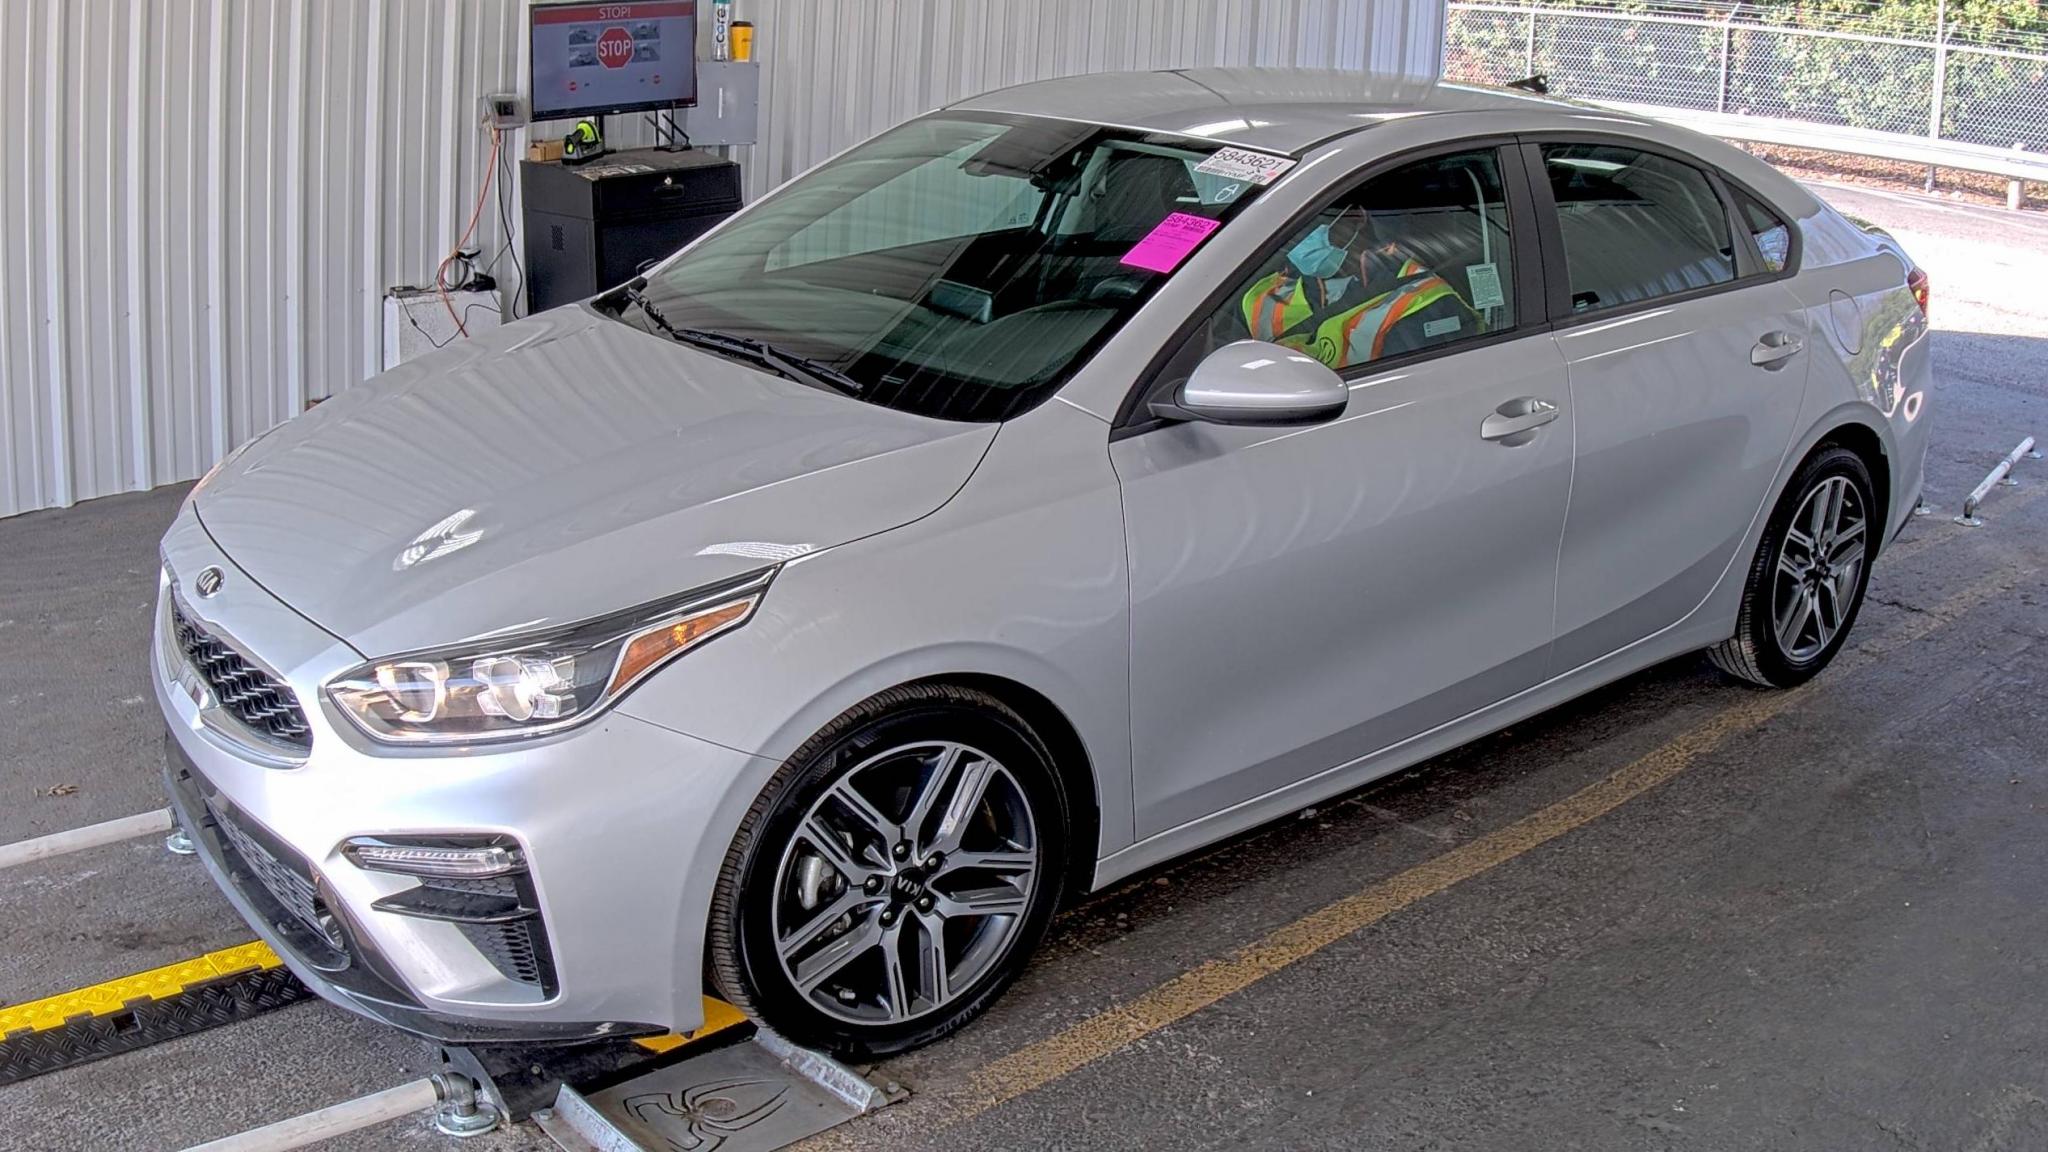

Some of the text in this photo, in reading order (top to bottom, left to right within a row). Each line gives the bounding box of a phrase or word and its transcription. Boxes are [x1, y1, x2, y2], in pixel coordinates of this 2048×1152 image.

[600, 6, 631, 19] STOP!
[600, 40, 631, 57] STOP
[1213, 149, 1285, 171] 5843621
[199, 570, 219, 593] KIA
[897, 875, 921, 896] KIA
